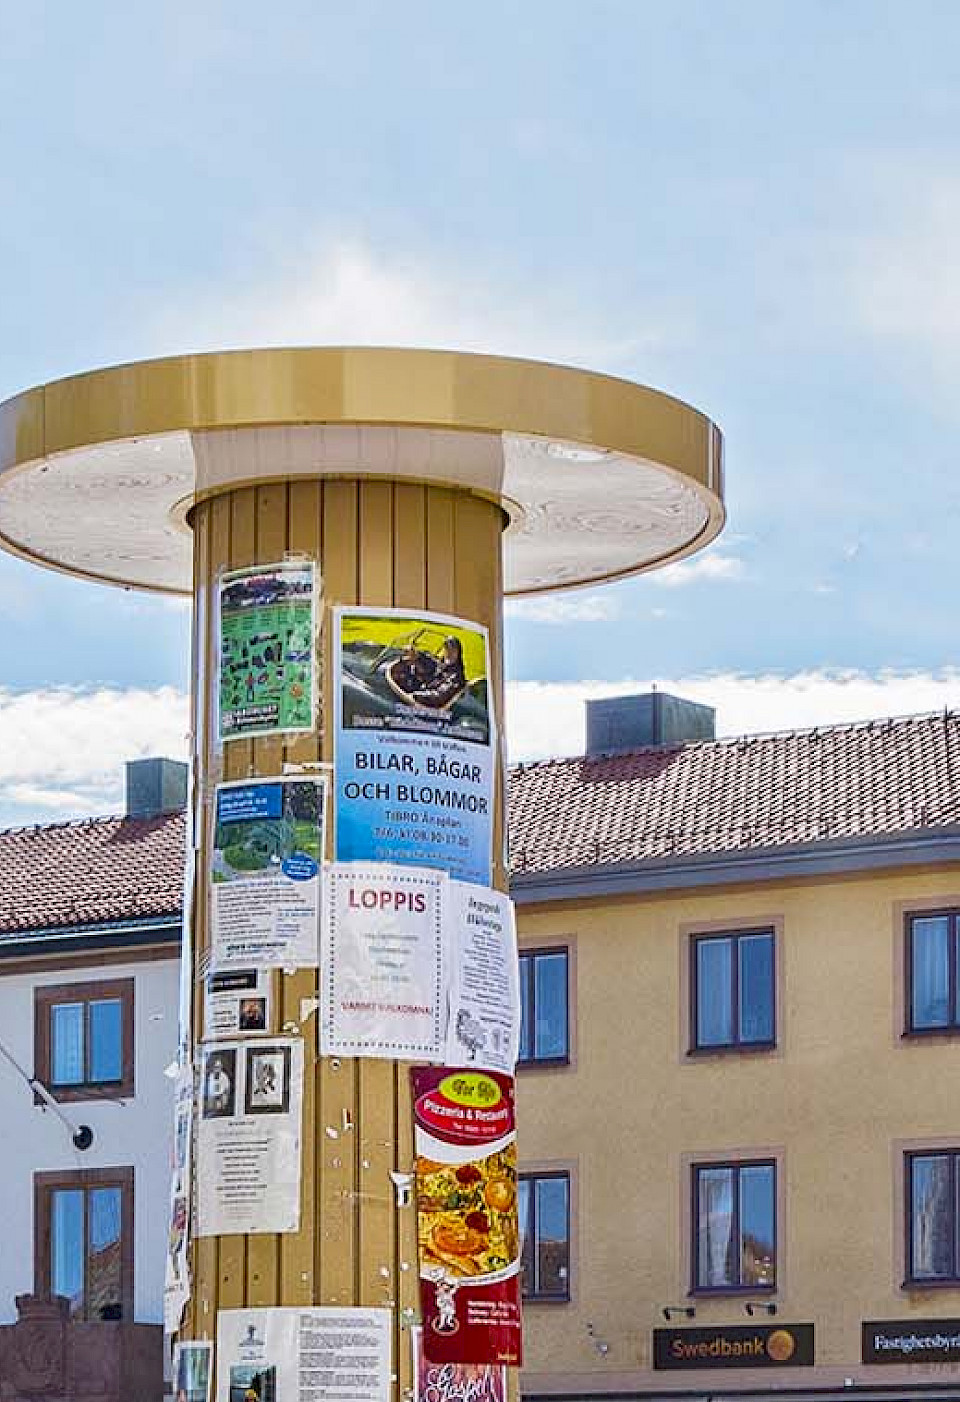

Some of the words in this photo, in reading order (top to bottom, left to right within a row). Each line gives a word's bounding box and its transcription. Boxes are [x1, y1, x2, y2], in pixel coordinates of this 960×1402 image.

[355, 752, 419, 776] BILAR,
[427, 753, 481, 783] BÅGAR
[345, 783, 390, 800] OCH
[398, 785, 487, 814] BLOMMOR
[349, 888, 426, 913] LOPPIS
[671, 1337, 766, 1358] Swedbank
